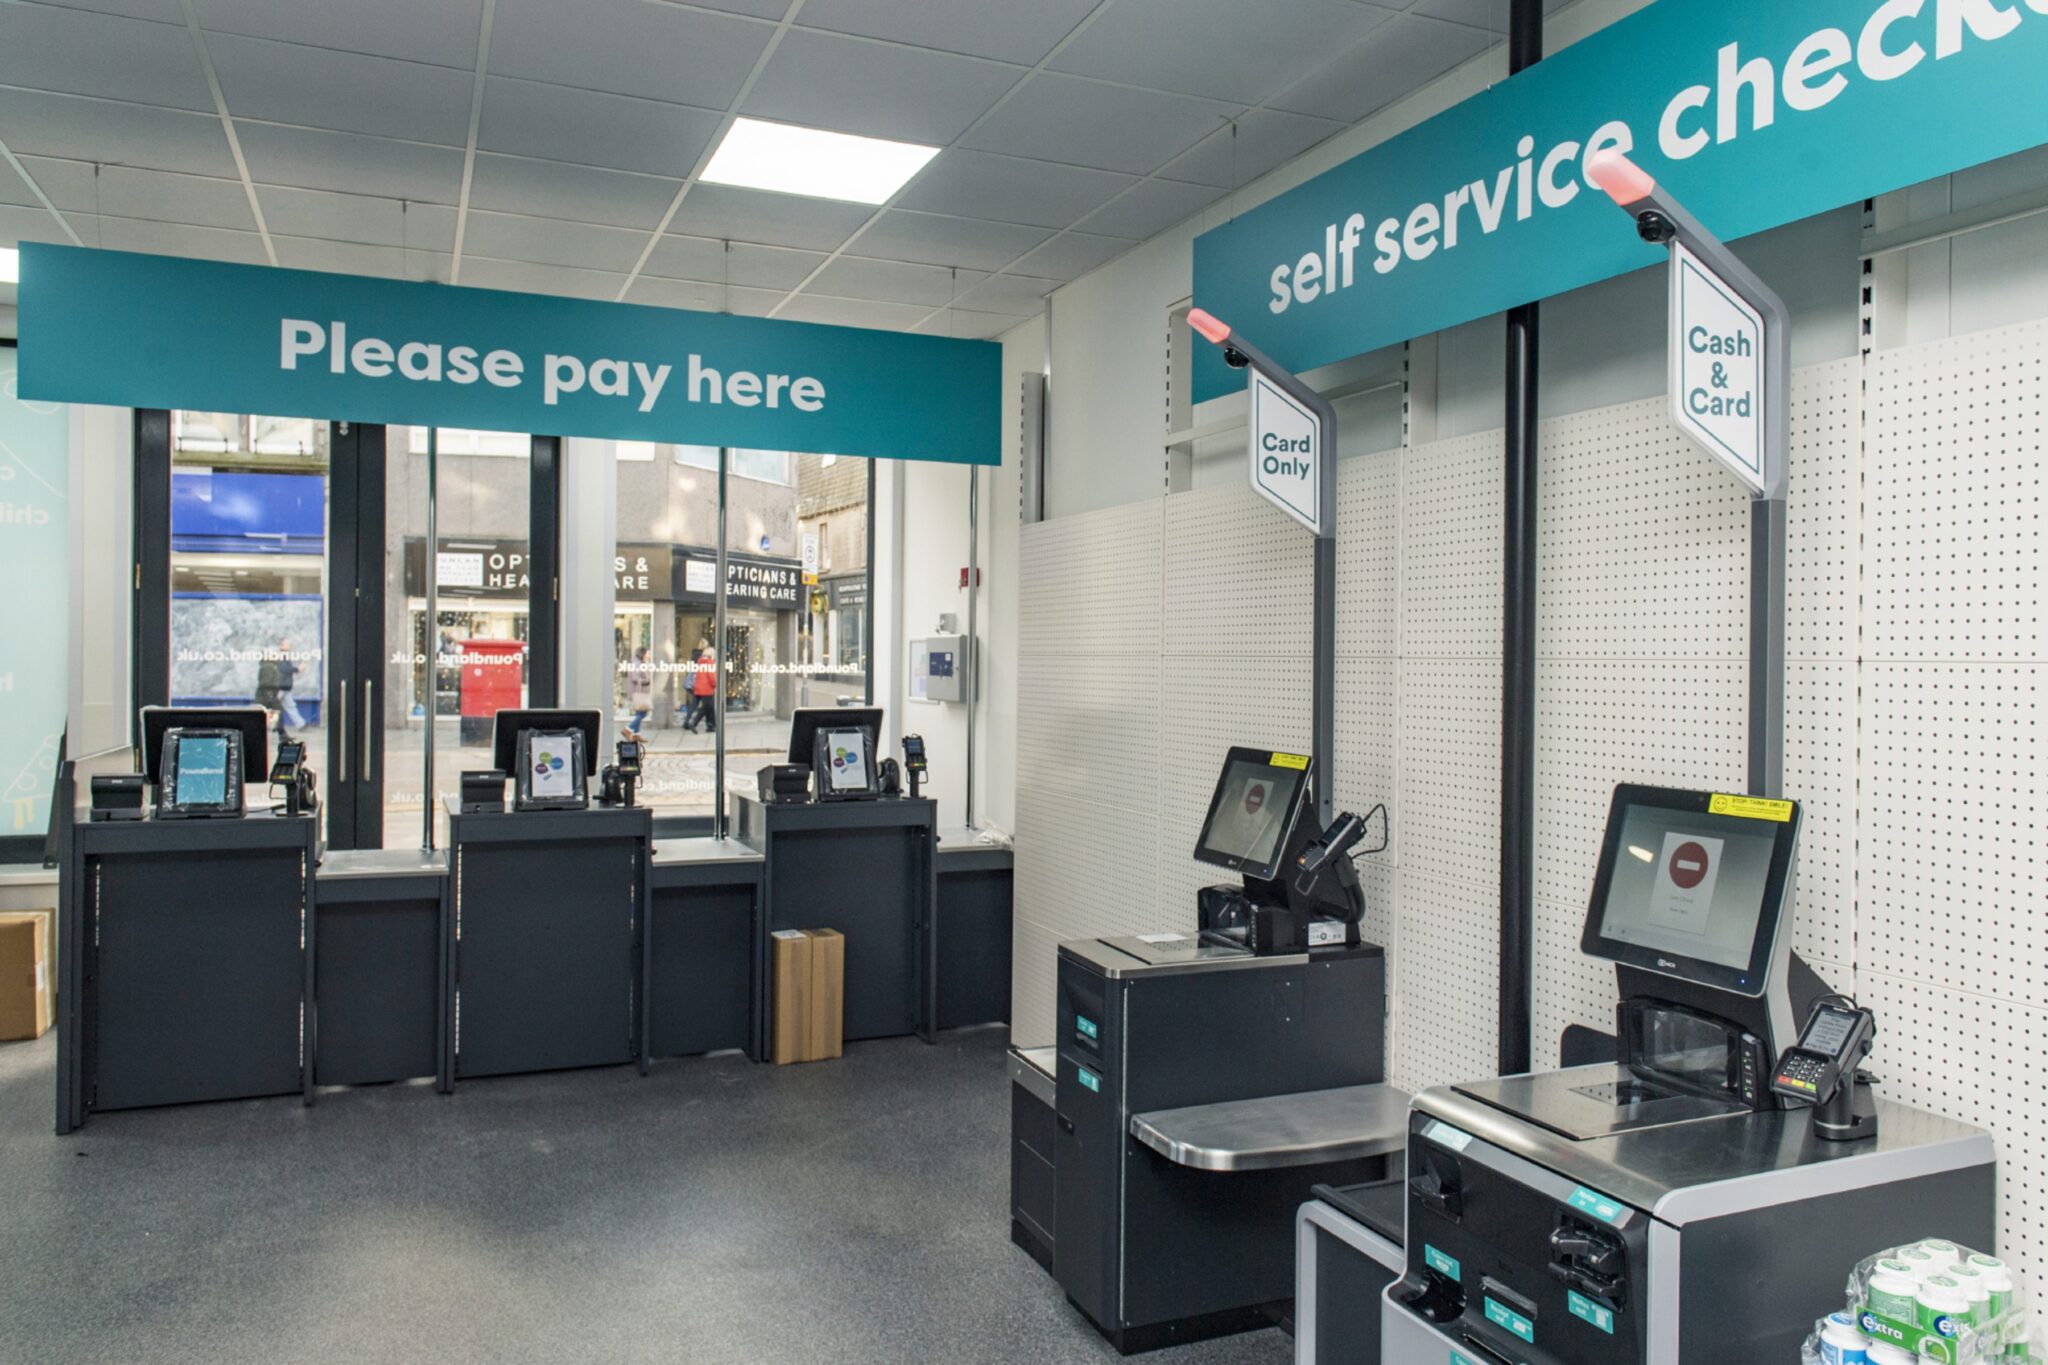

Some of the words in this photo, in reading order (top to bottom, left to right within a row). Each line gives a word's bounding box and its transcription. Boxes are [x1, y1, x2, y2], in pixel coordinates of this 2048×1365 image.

[1269, 213, 1365, 315] self
[1373, 120, 1633, 274] service
[1658, 0, 2048, 160] check
[1688, 325, 1751, 357] Cash
[280, 318, 524, 388] Please
[544, 353, 672, 413] pay
[688, 353, 826, 412] here
[1710, 361, 1728, 389] &
[1689, 387, 1751, 418] Card
[1262, 432, 1311, 453] Card
[1263, 455, 1311, 480] Only
[728, 564, 787, 585] PTICIANS
[726, 582, 767, 599] EARING
[769, 586, 797, 601] CARE
[1862, 1316, 1903, 1340] extra
